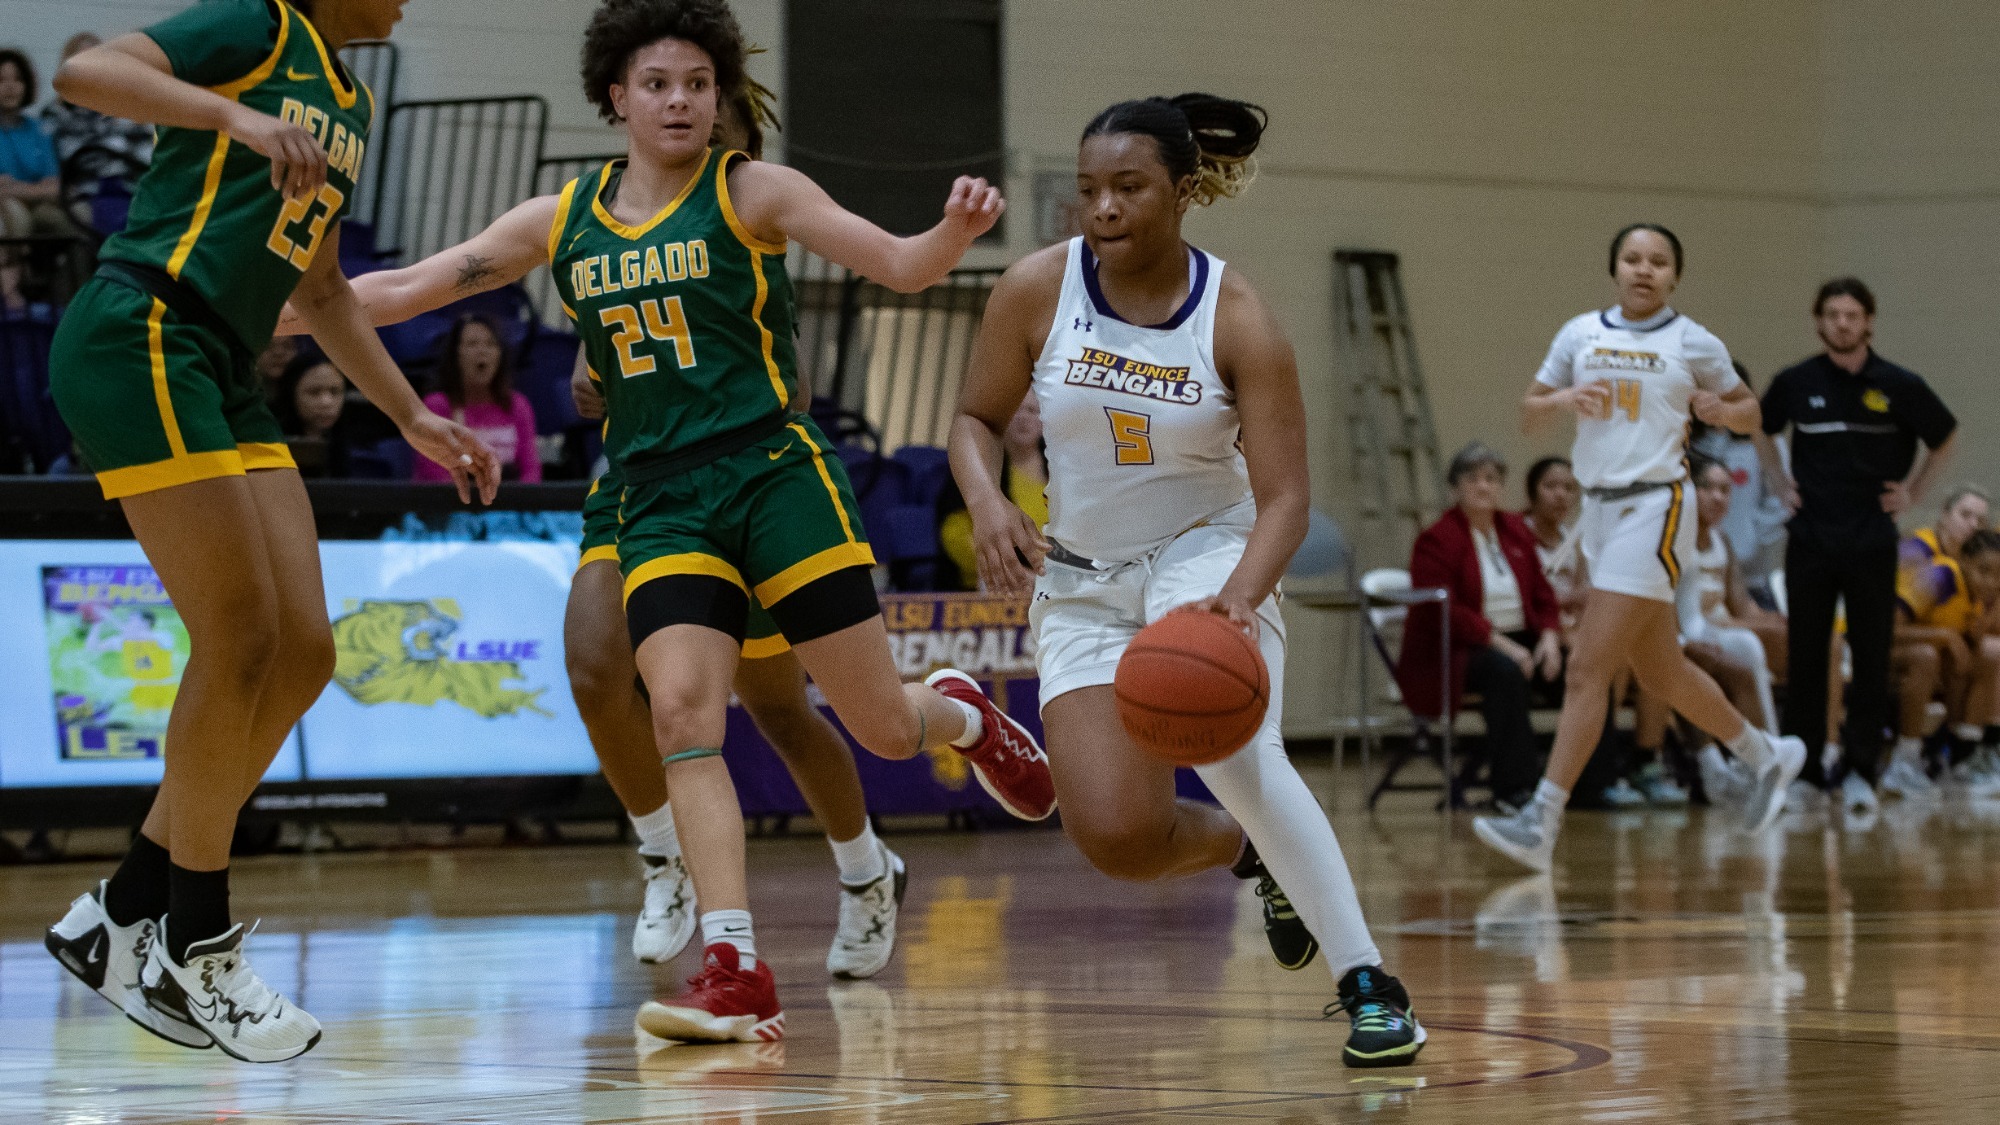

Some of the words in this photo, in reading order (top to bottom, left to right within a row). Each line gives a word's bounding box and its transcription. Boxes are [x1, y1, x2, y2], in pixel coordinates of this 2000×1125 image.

[267, 183, 344, 272] 23
[571, 239, 710, 301] DELGADO
[599, 295, 697, 379] 24
[1065, 360, 1202, 405] BENGALS
[1081, 349, 1118, 368] LSU
[1123, 359, 1188, 382] EUNICE
[1103, 406, 1154, 466] 5
[885, 601, 935, 630] LSU
[457, 640, 540, 661] LSUE
